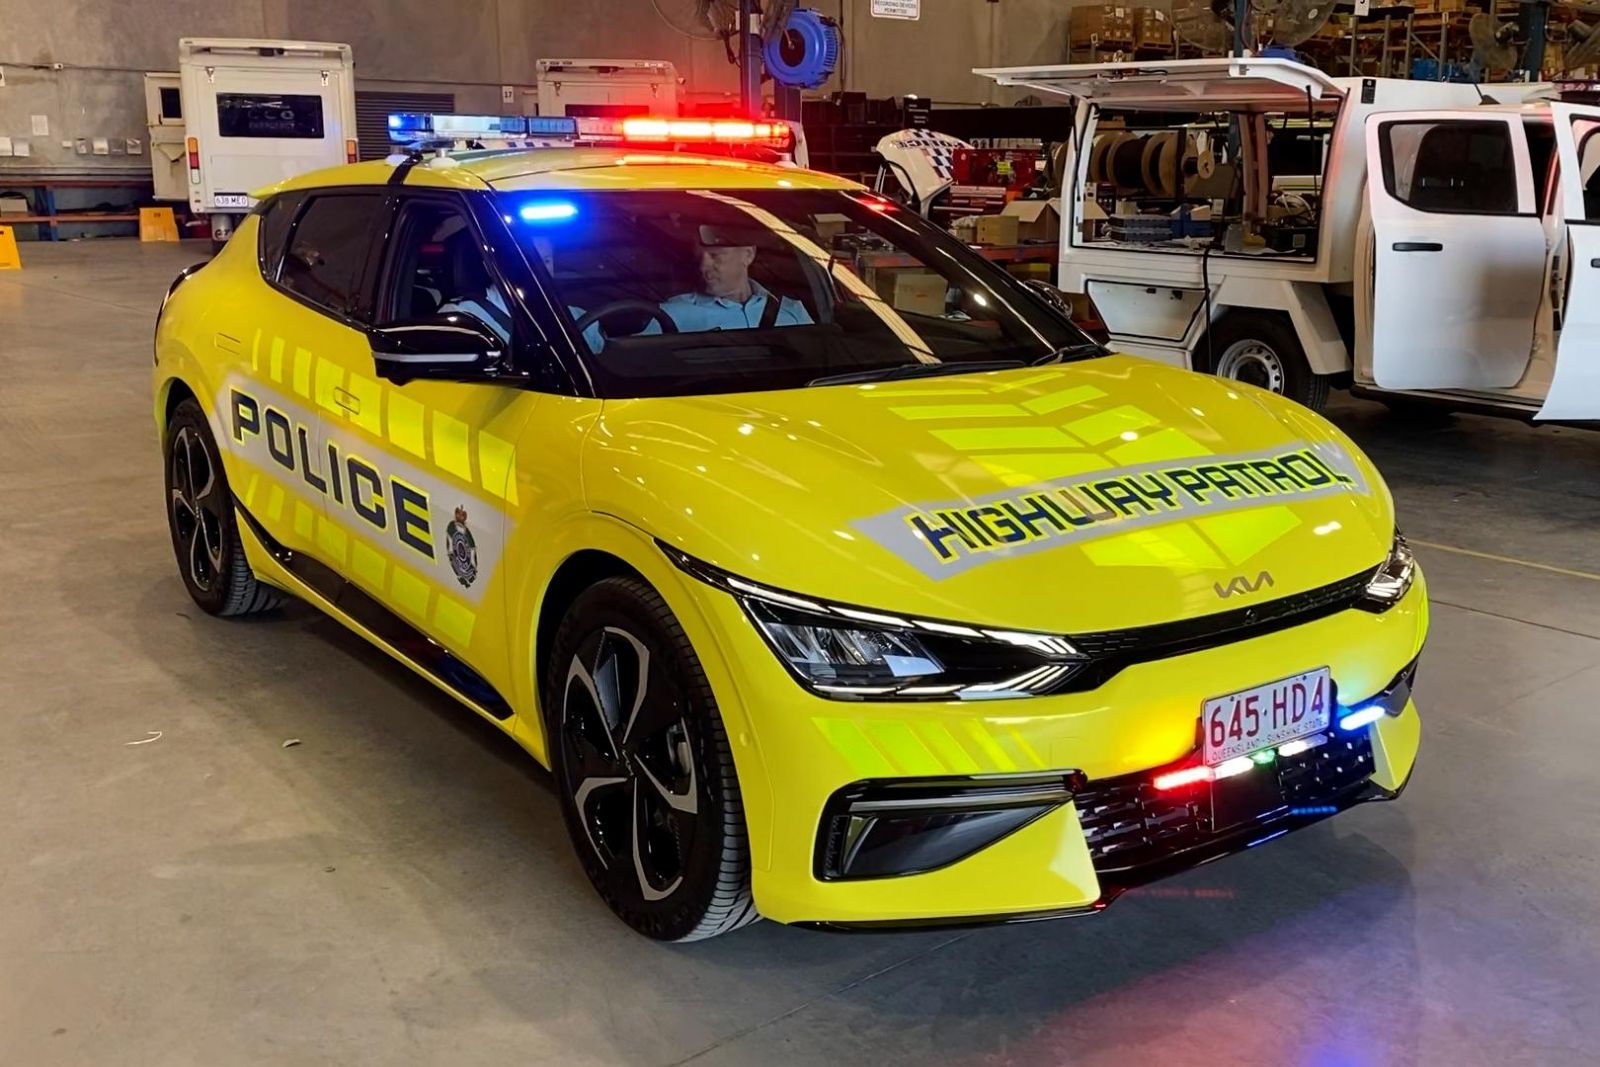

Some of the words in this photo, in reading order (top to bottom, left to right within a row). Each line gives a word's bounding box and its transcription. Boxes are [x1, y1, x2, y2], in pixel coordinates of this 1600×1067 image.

[230, 387, 436, 561] POLICE
[909, 476, 1174, 560] HIGHWAY
[1174, 449, 1351, 504] PATROL
[1214, 571, 1274, 598] KIA
